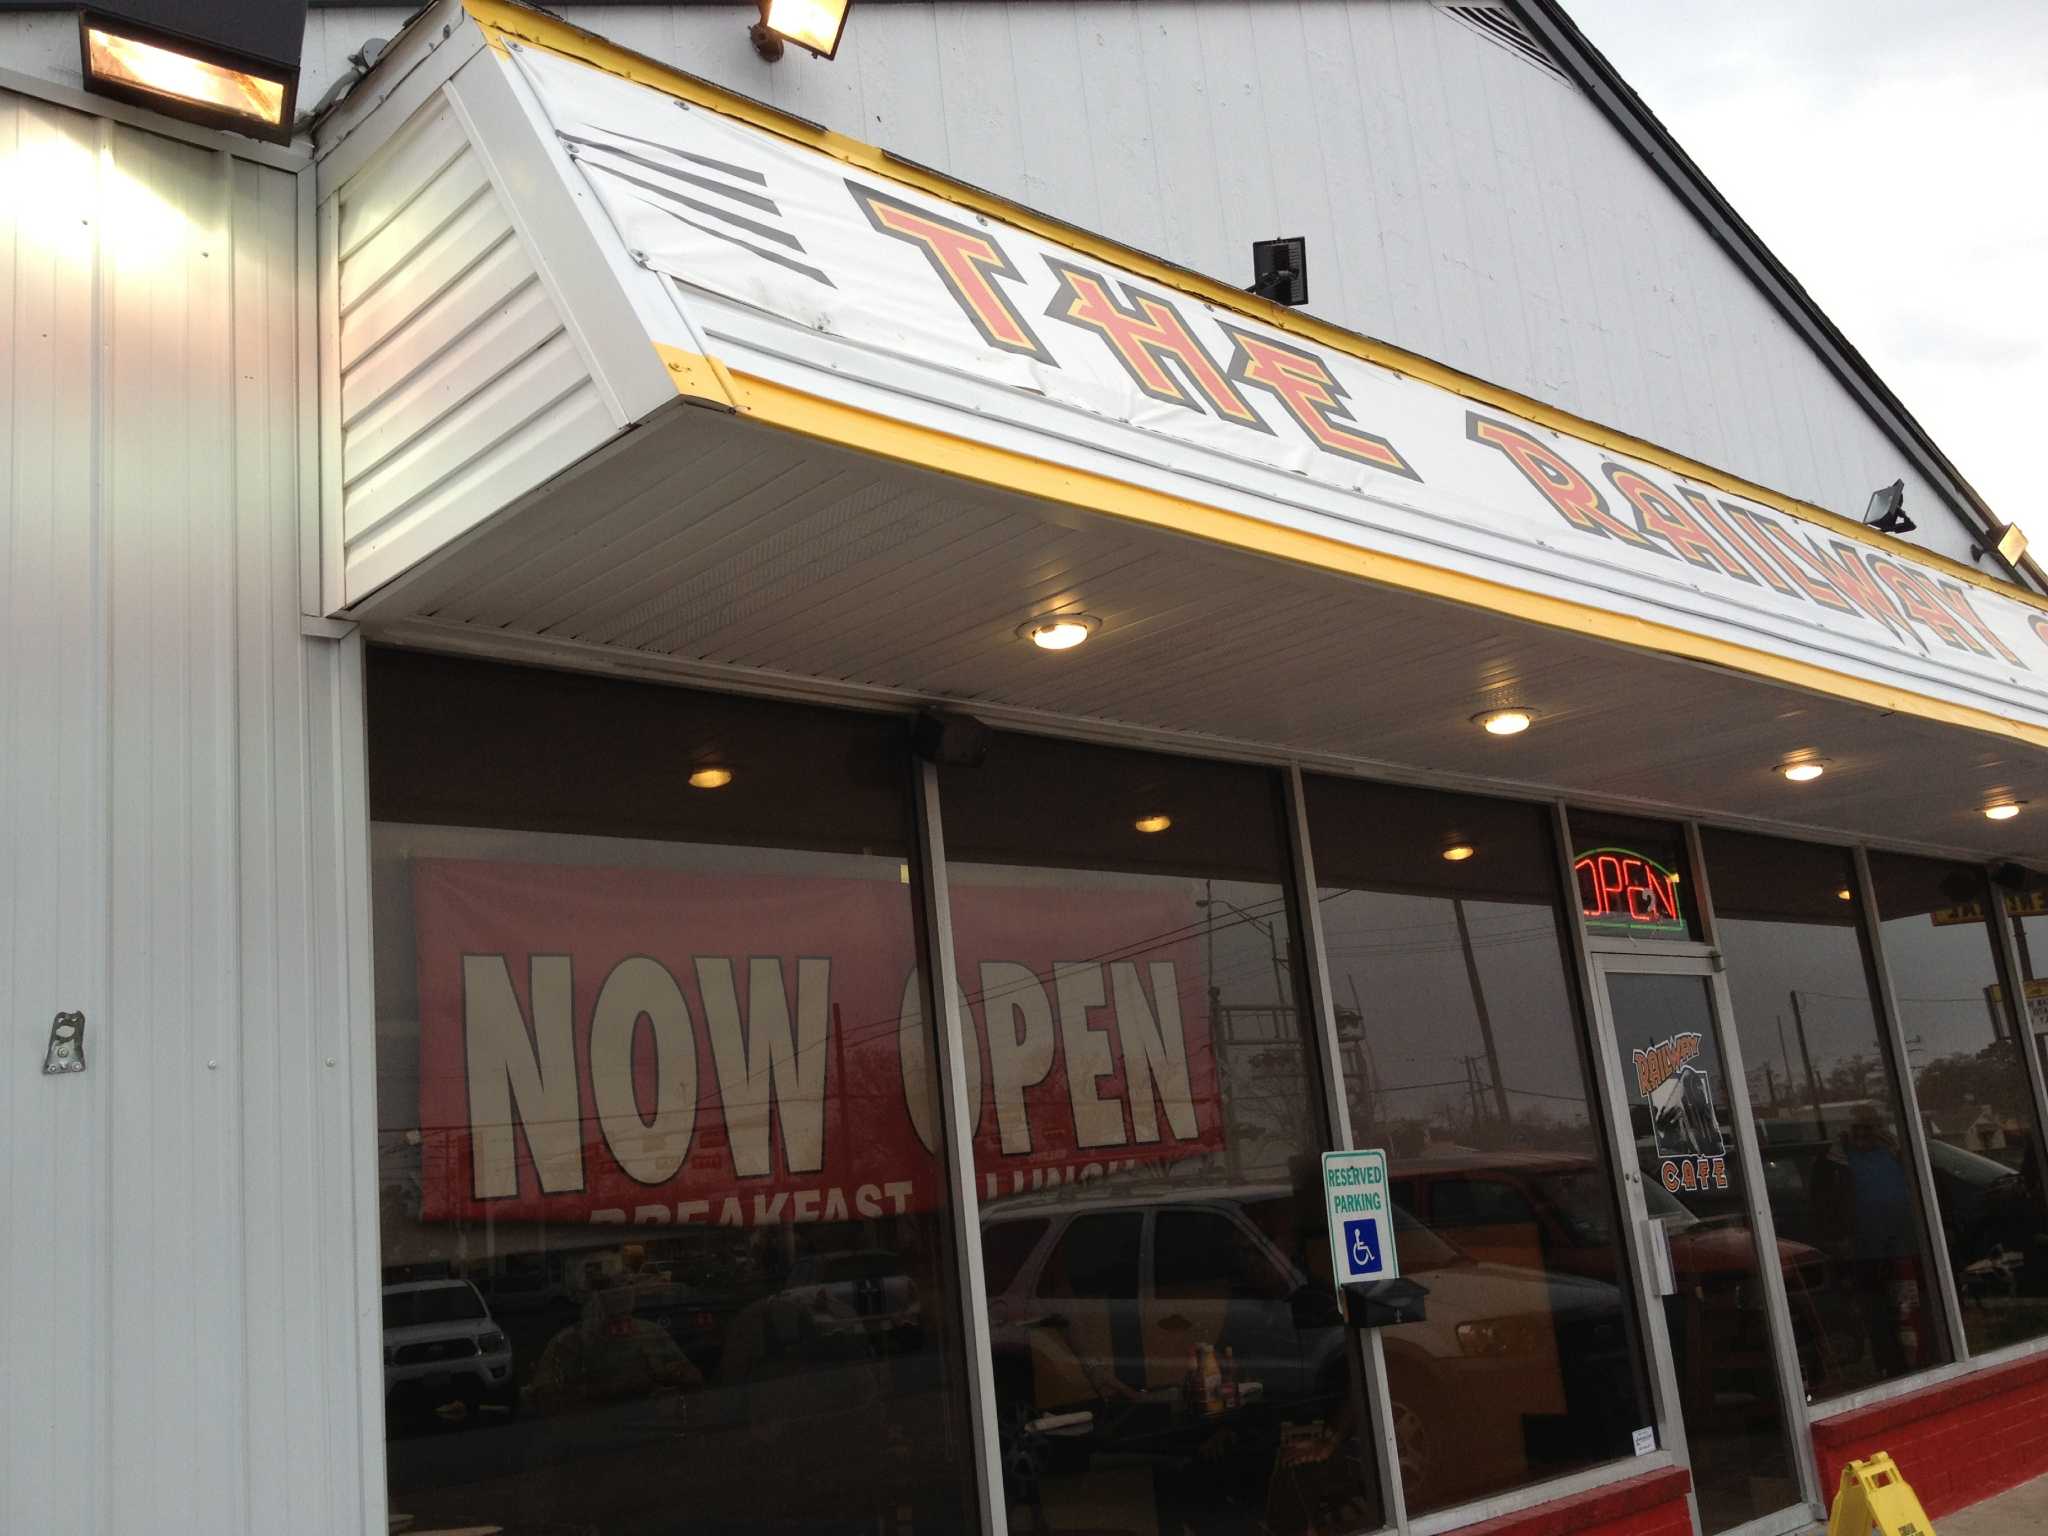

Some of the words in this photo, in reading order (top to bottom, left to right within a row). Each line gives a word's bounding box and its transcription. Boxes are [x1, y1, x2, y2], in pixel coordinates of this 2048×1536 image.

[843, 177, 1425, 484] THE
[1466, 410, 2032, 671] RAILWAY
[1574, 855, 1678, 922] OPEN
[461, 953, 832, 1200] NOW
[898, 960, 1199, 1158] OPEN
[1633, 1032, 1702, 1097] RAILWAY
[1328, 1166, 1382, 1187] RESERVED
[1333, 1191, 1382, 1214] PARKING
[1661, 1157, 1728, 1193] CAFE
